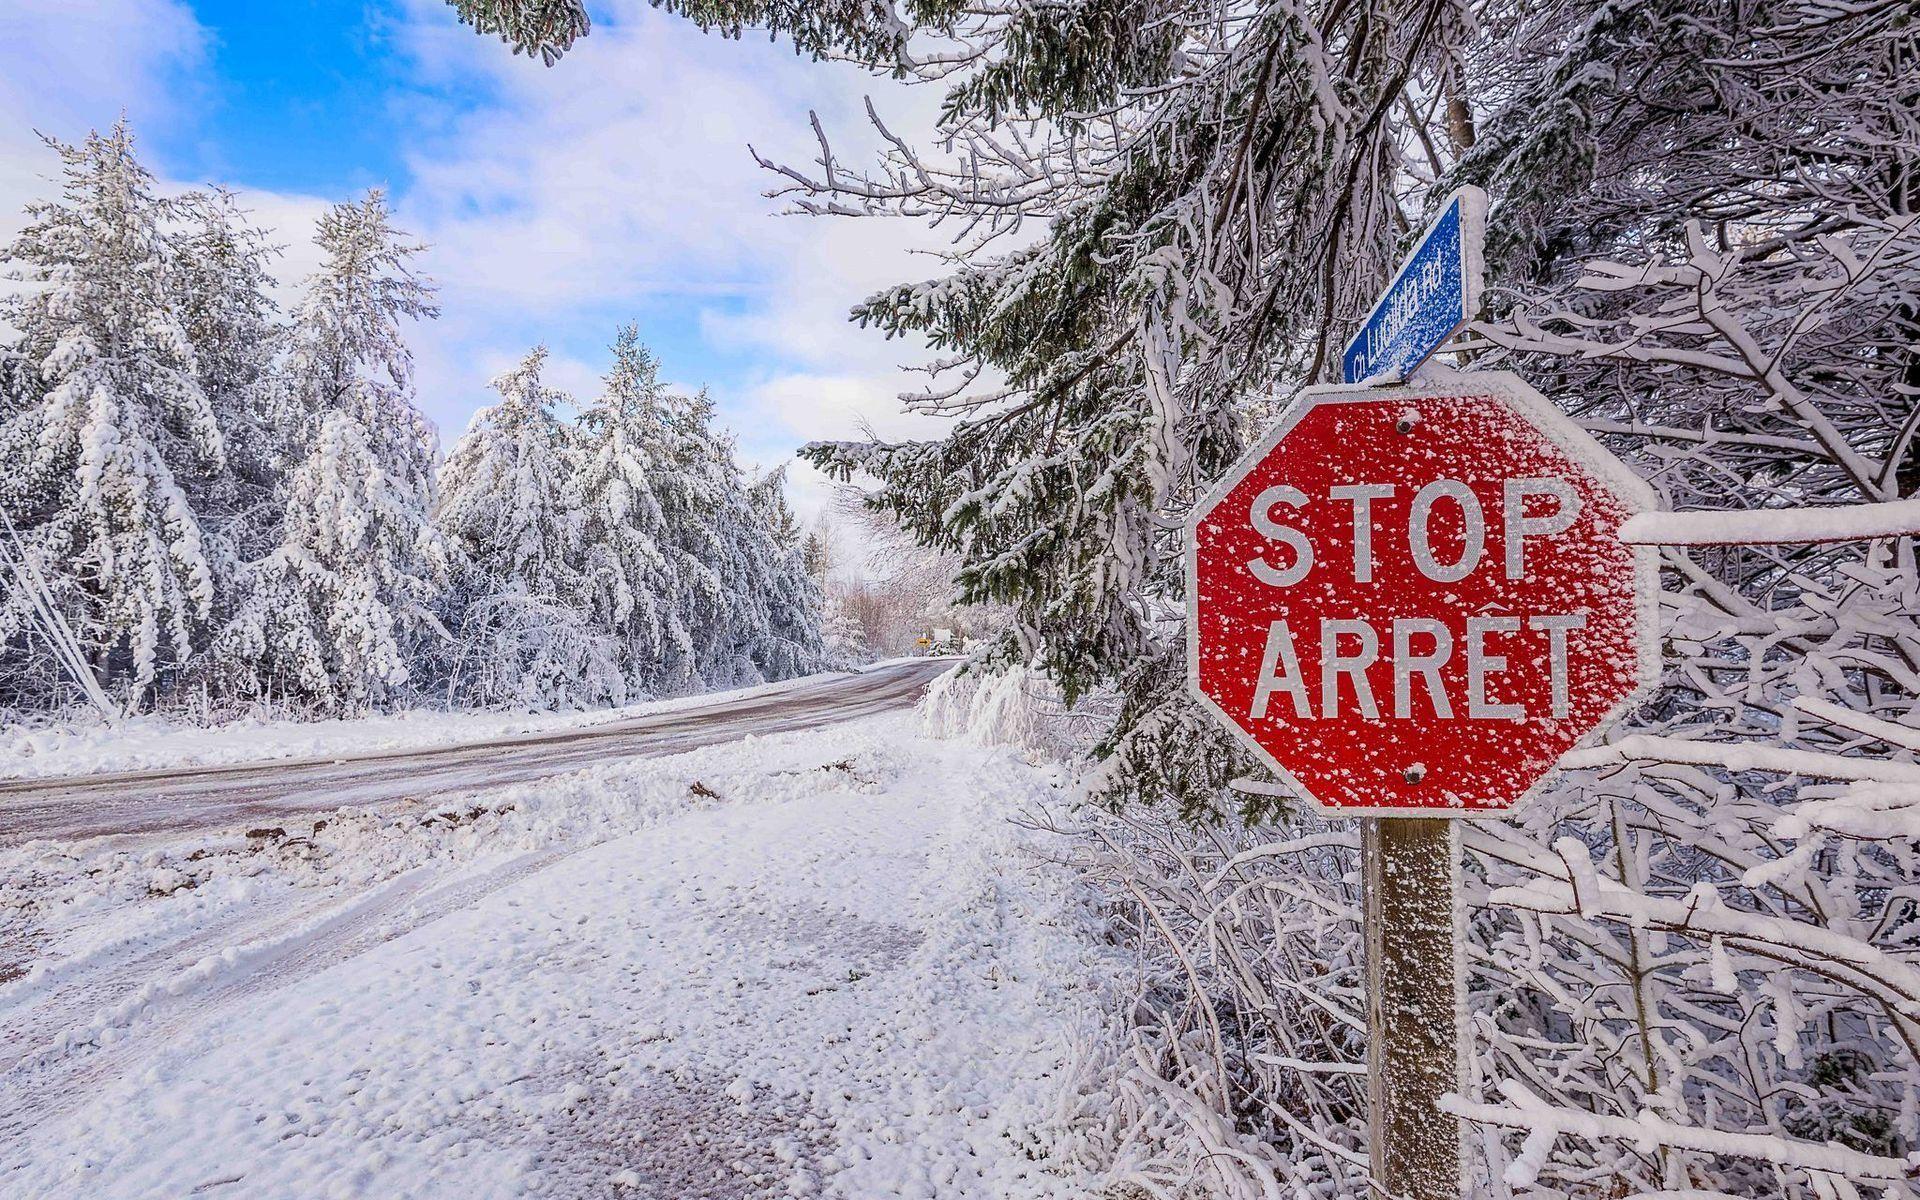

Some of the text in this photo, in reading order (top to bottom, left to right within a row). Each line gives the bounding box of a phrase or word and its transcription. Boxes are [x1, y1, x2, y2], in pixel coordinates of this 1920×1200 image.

[1353, 351, 1366, 383] Ch
[1422, 247, 1441, 302] Rd
[1246, 477, 1582, 587] STOP
[1249, 601, 1587, 720] ARRÊT
